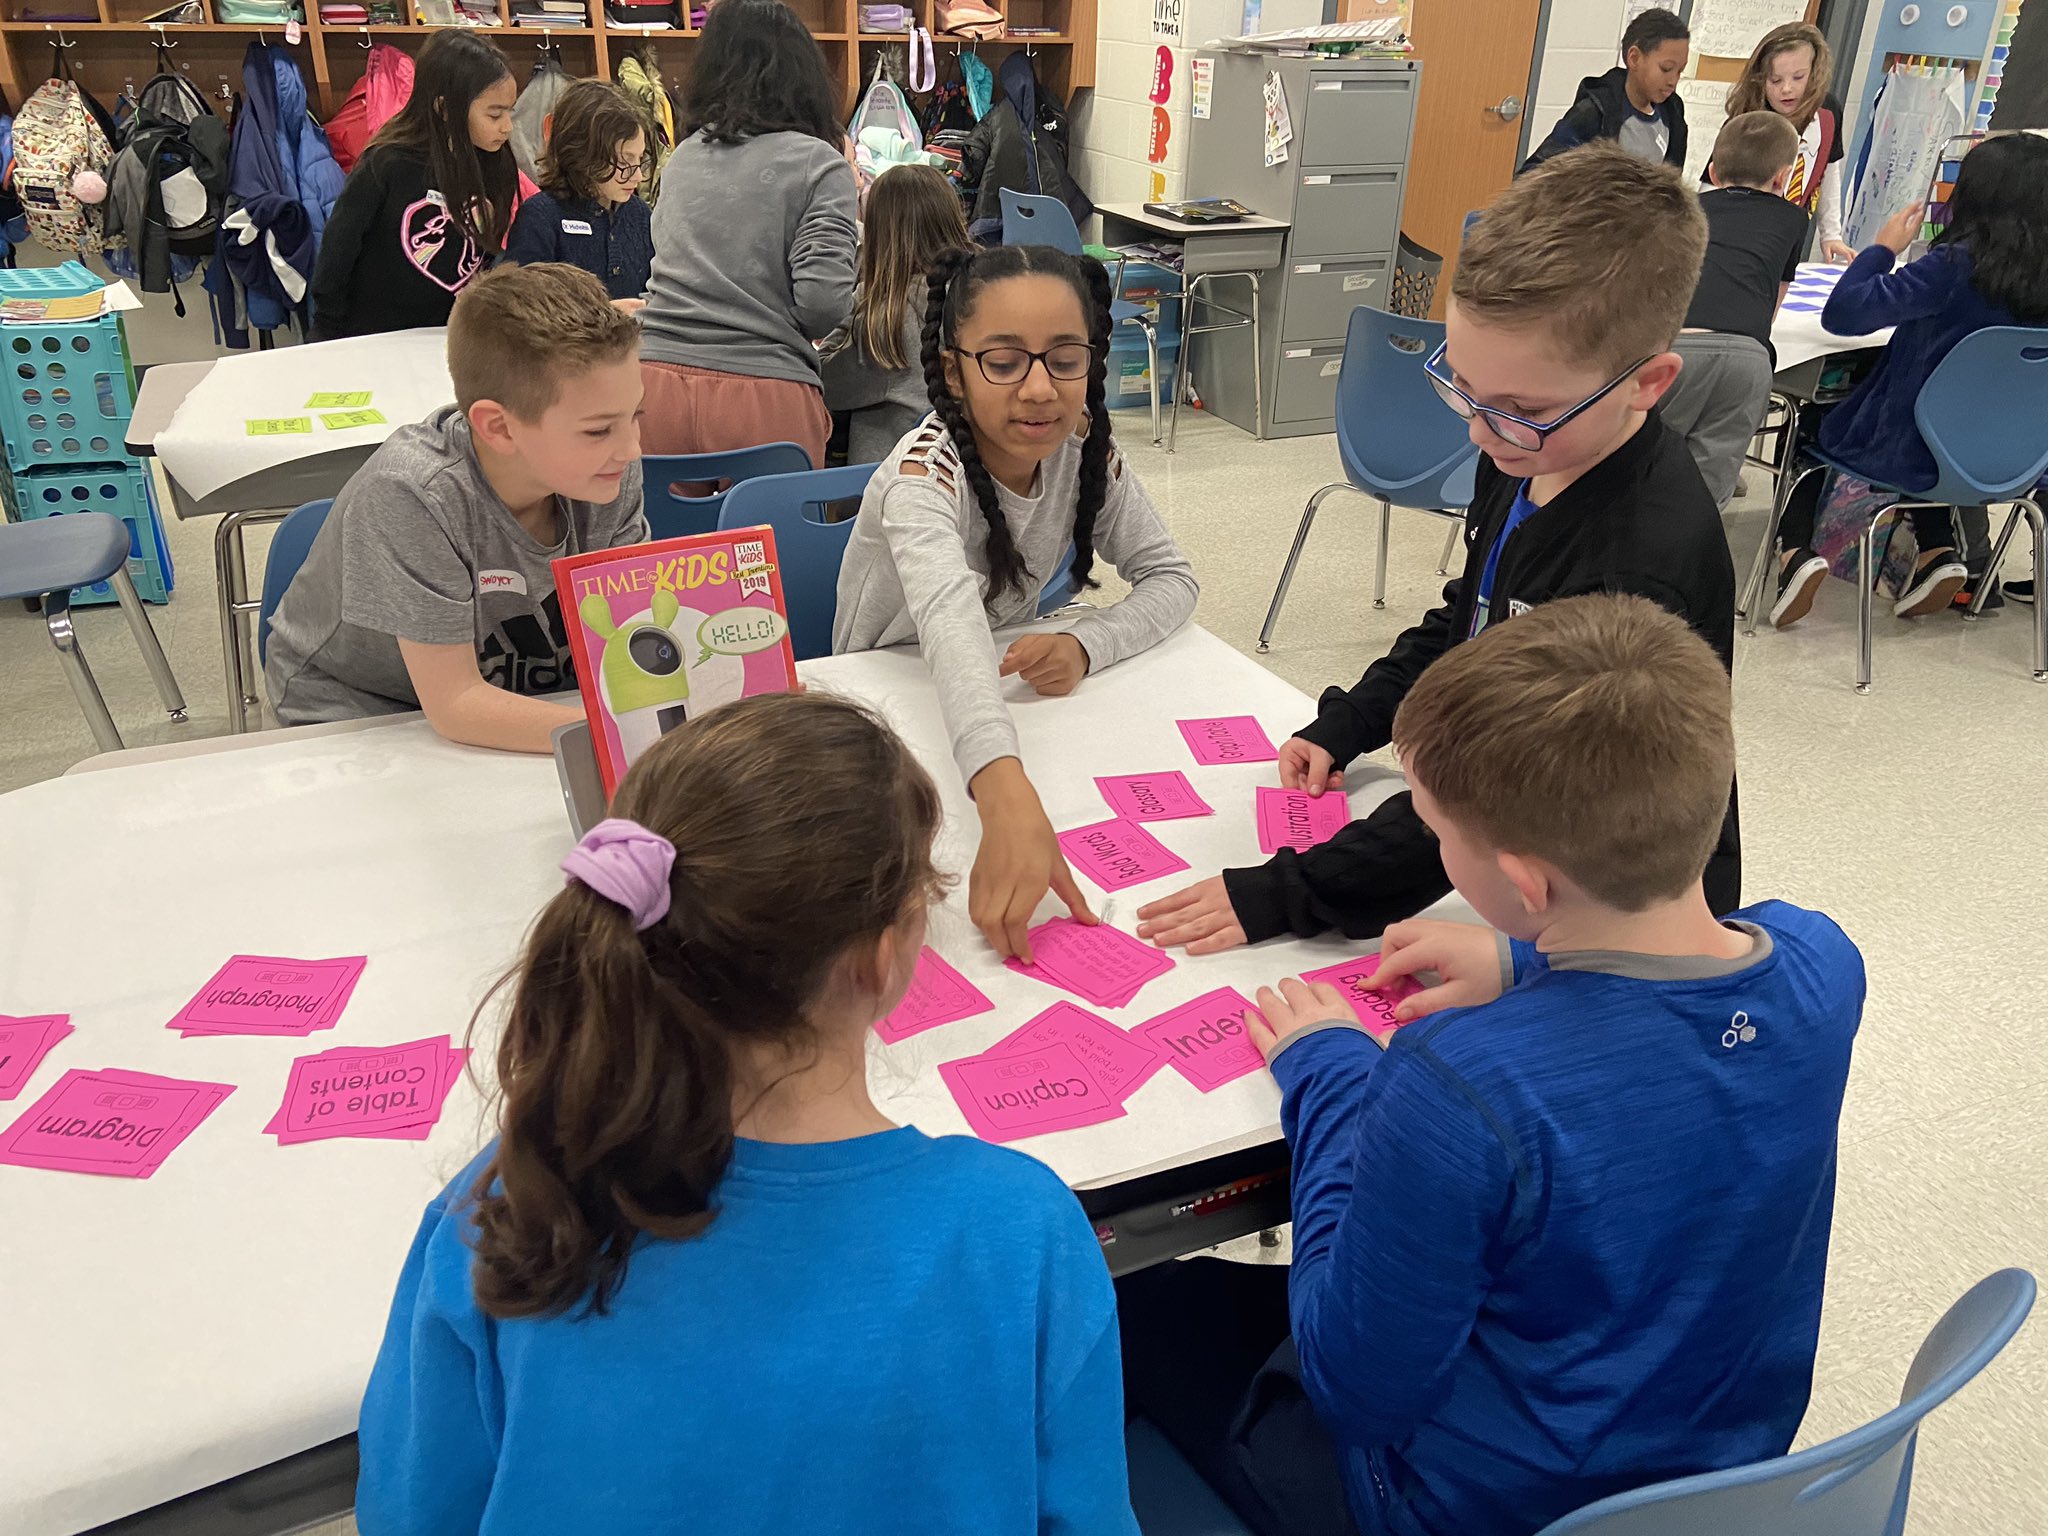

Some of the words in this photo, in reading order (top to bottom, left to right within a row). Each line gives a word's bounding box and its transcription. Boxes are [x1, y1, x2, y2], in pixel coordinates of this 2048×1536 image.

[1153, 20, 1160, 33] TO
[1161, 22, 1174, 36] TAKE
[1175, 24, 1179, 36] A
[736, 542, 762, 554] TIME
[740, 552, 763, 565] KiDS
[577, 567, 649, 597] TIME
[654, 550, 729, 593] KiDS
[747, 563, 774, 577] Inventions
[743, 576, 767, 590] 2019
[712, 614, 776, 646] HELLO!
[1125, 781, 1166, 815] Glossary
[1280, 795, 1313, 849] Illustration
[1079, 831, 1124, 861] Words
[1103, 857, 1146, 879] Bold
[206, 988, 324, 1014] Photograph
[1074, 1031, 1096, 1049] text
[1097, 1044, 1115, 1058] the
[1088, 1052, 1110, 1070] bold
[1111, 1062, 1125, 1075] of
[309, 1065, 426, 1097] Contents
[1098, 1069, 1120, 1087] Tells
[347, 1088, 420, 1116] Table
[984, 1078, 1088, 1111] Caption
[305, 1096, 337, 1125] of
[36, 1115, 164, 1149] Diagram
